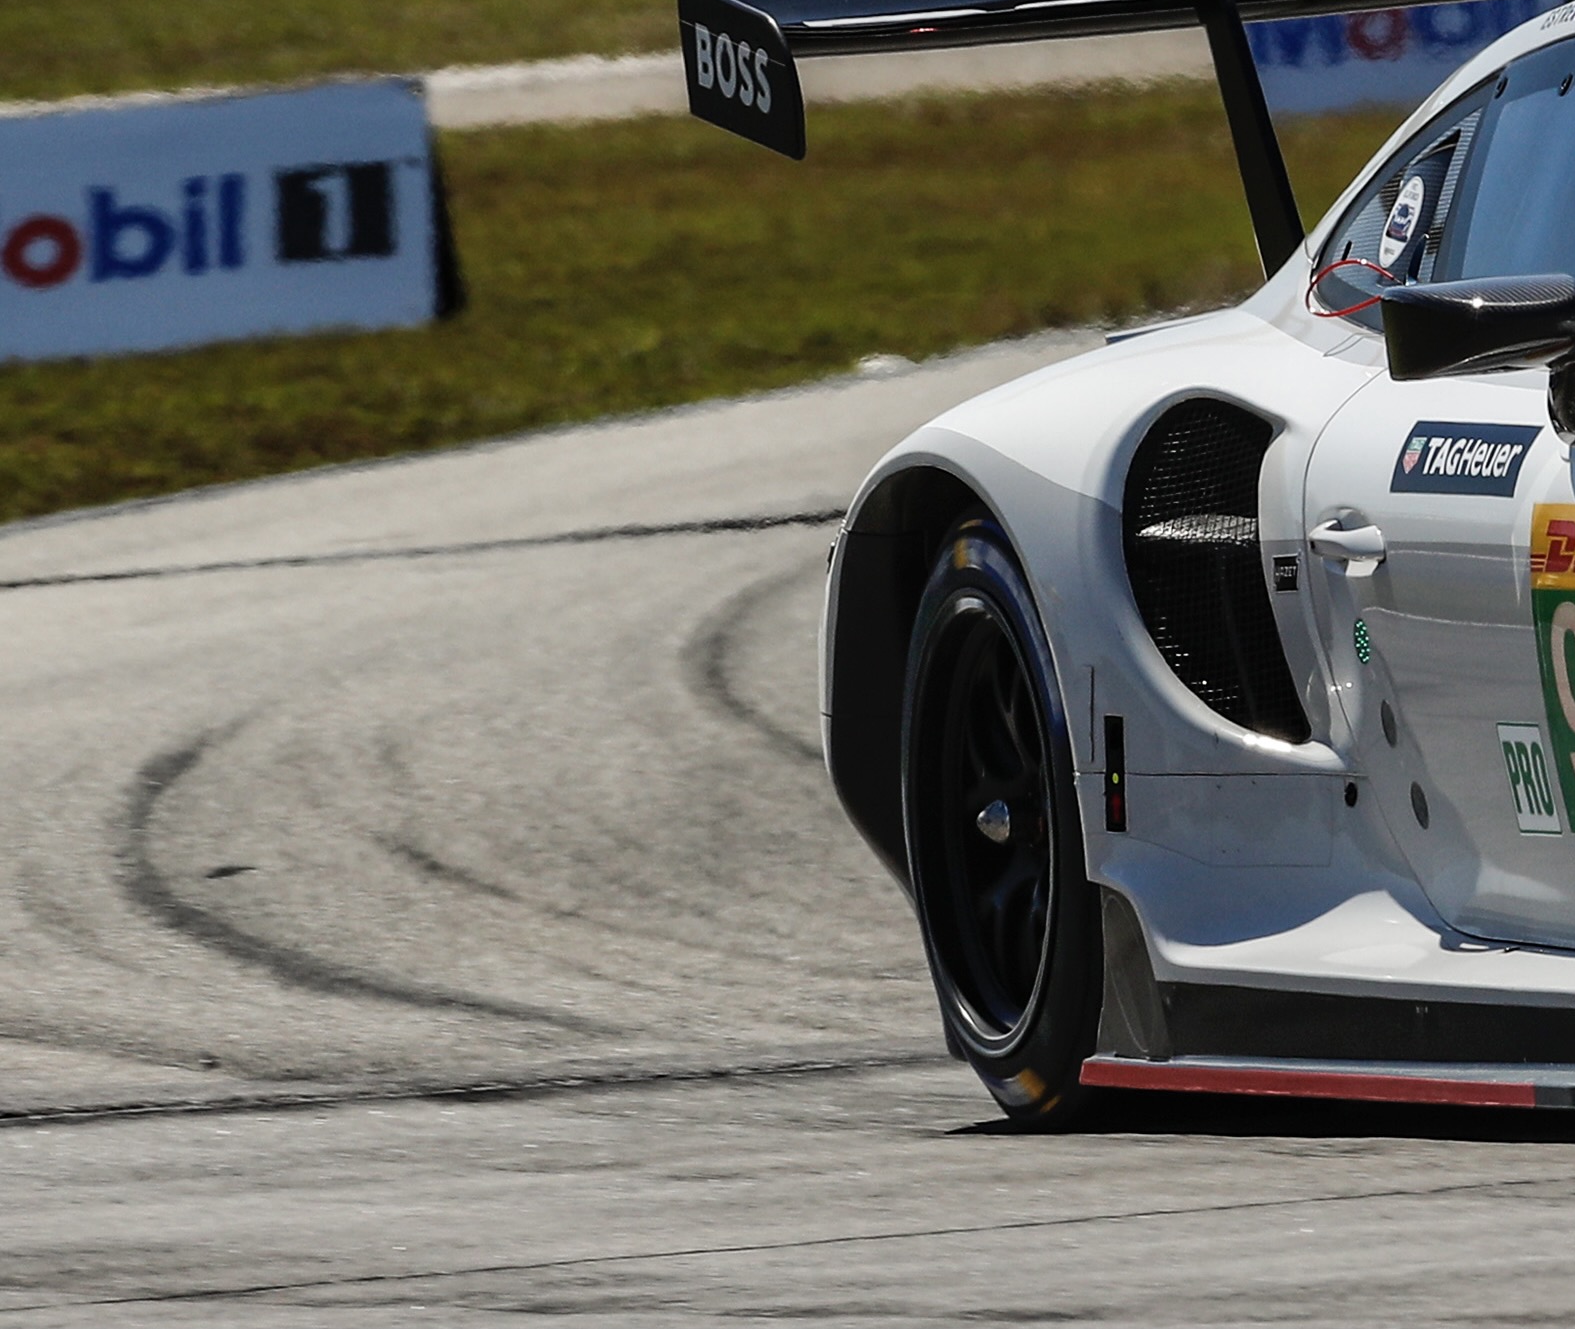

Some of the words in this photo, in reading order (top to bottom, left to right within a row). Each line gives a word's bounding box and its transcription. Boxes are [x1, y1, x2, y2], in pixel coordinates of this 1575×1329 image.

[695, 23, 772, 114] BOSS
[0, 173, 246, 290] obil
[1503, 740, 1555, 816] PRO
